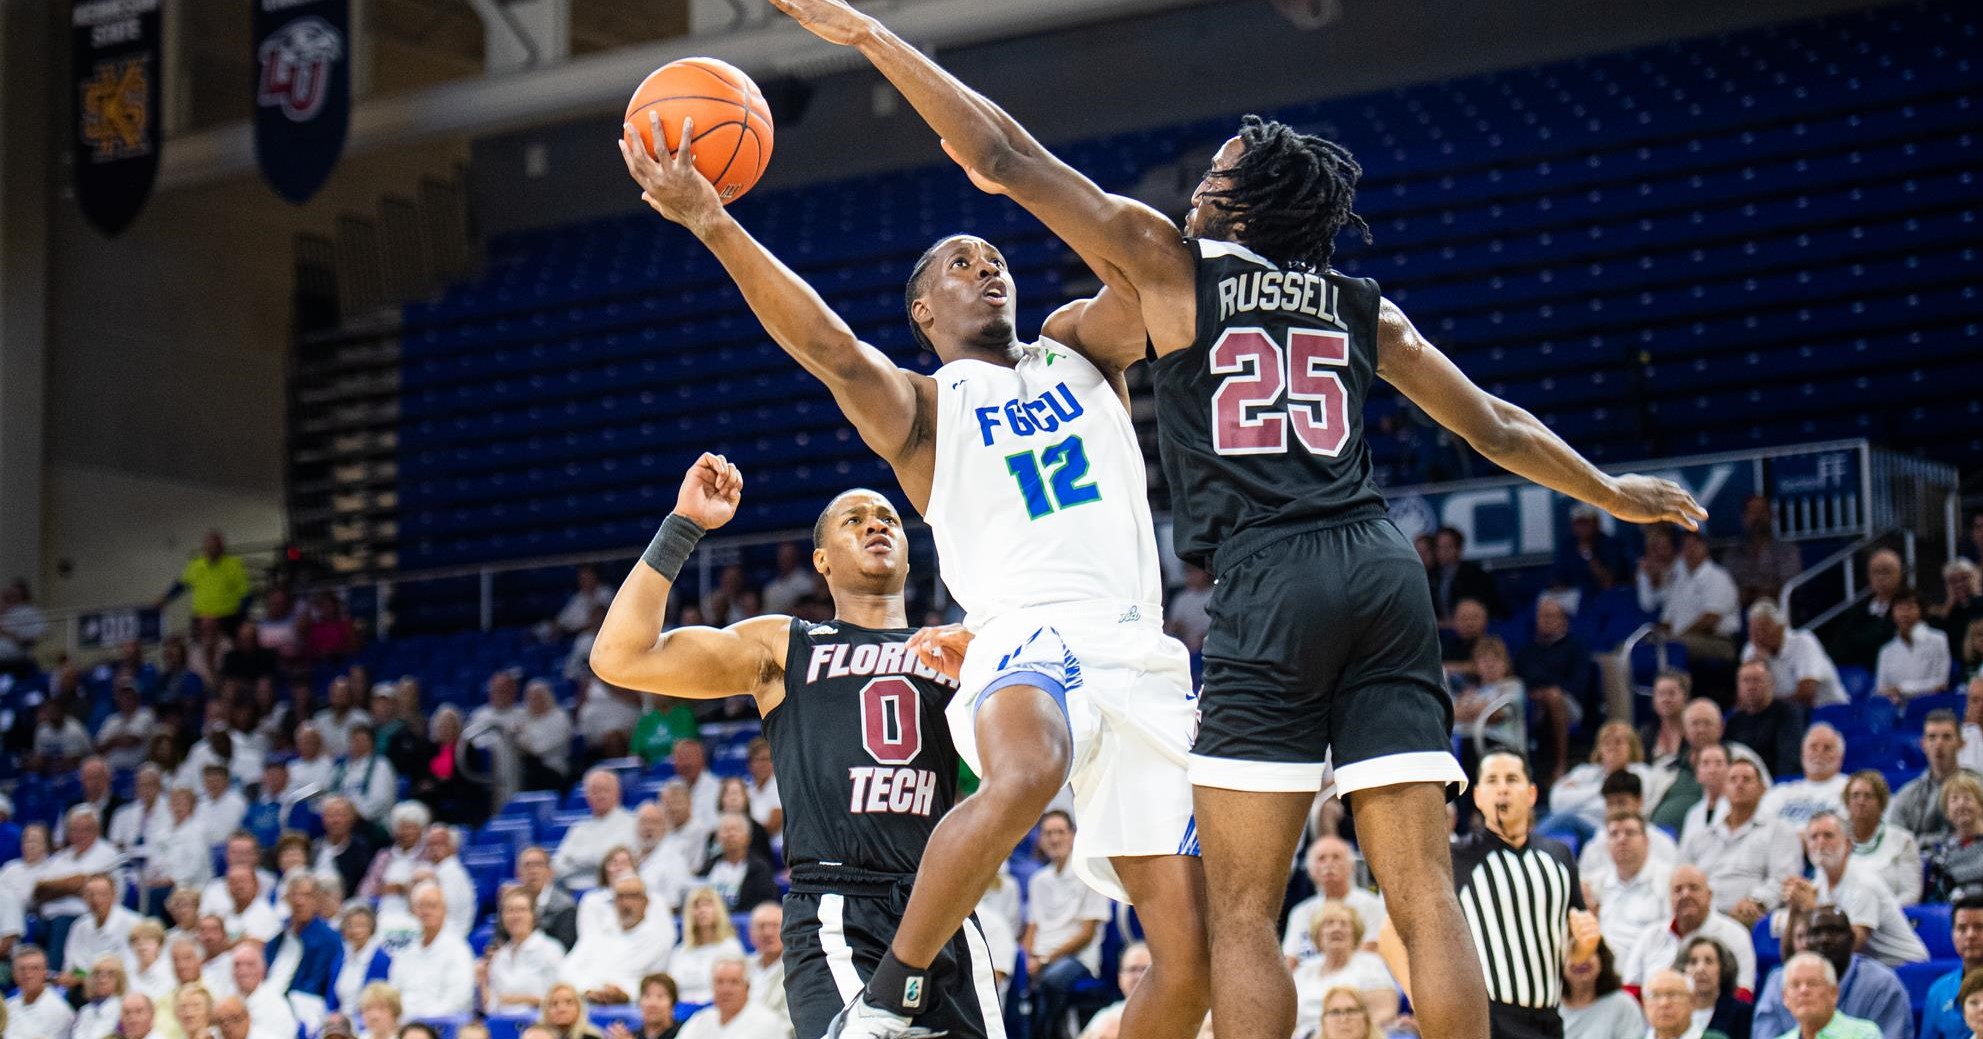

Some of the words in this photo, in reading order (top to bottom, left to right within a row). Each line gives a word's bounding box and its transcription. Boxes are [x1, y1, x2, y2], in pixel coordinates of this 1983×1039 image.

[1218, 271, 1349, 331] RUSSELL
[975, 381, 1084, 447] FGCU
[1209, 327, 1350, 458] 25
[1004, 434, 1103, 521] 12
[1443, 464, 1735, 557] CIY
[859, 675, 922, 765] 0
[848, 767, 937, 816] TECH
